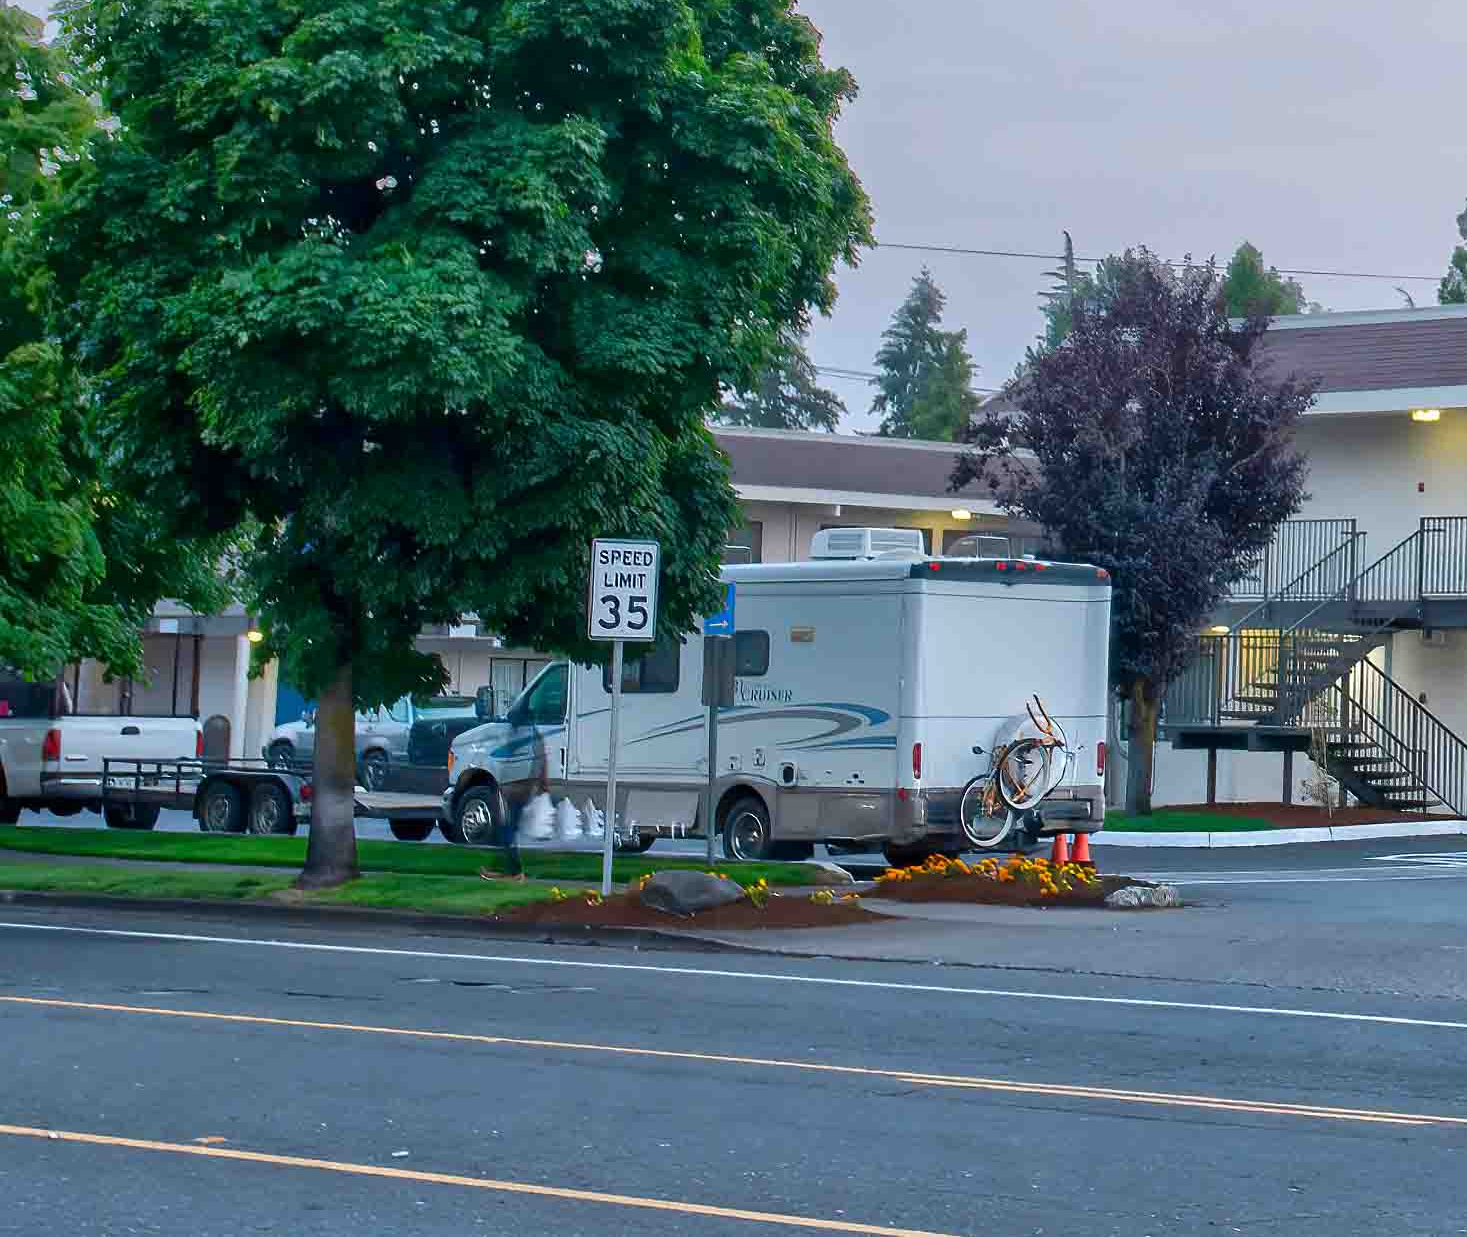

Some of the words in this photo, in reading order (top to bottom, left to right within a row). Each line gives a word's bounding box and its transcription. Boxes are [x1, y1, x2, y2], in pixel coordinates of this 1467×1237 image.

[599, 549, 654, 567] SPEED
[604, 572, 647, 589] LIMIT
[598, 594, 649, 630] 35
